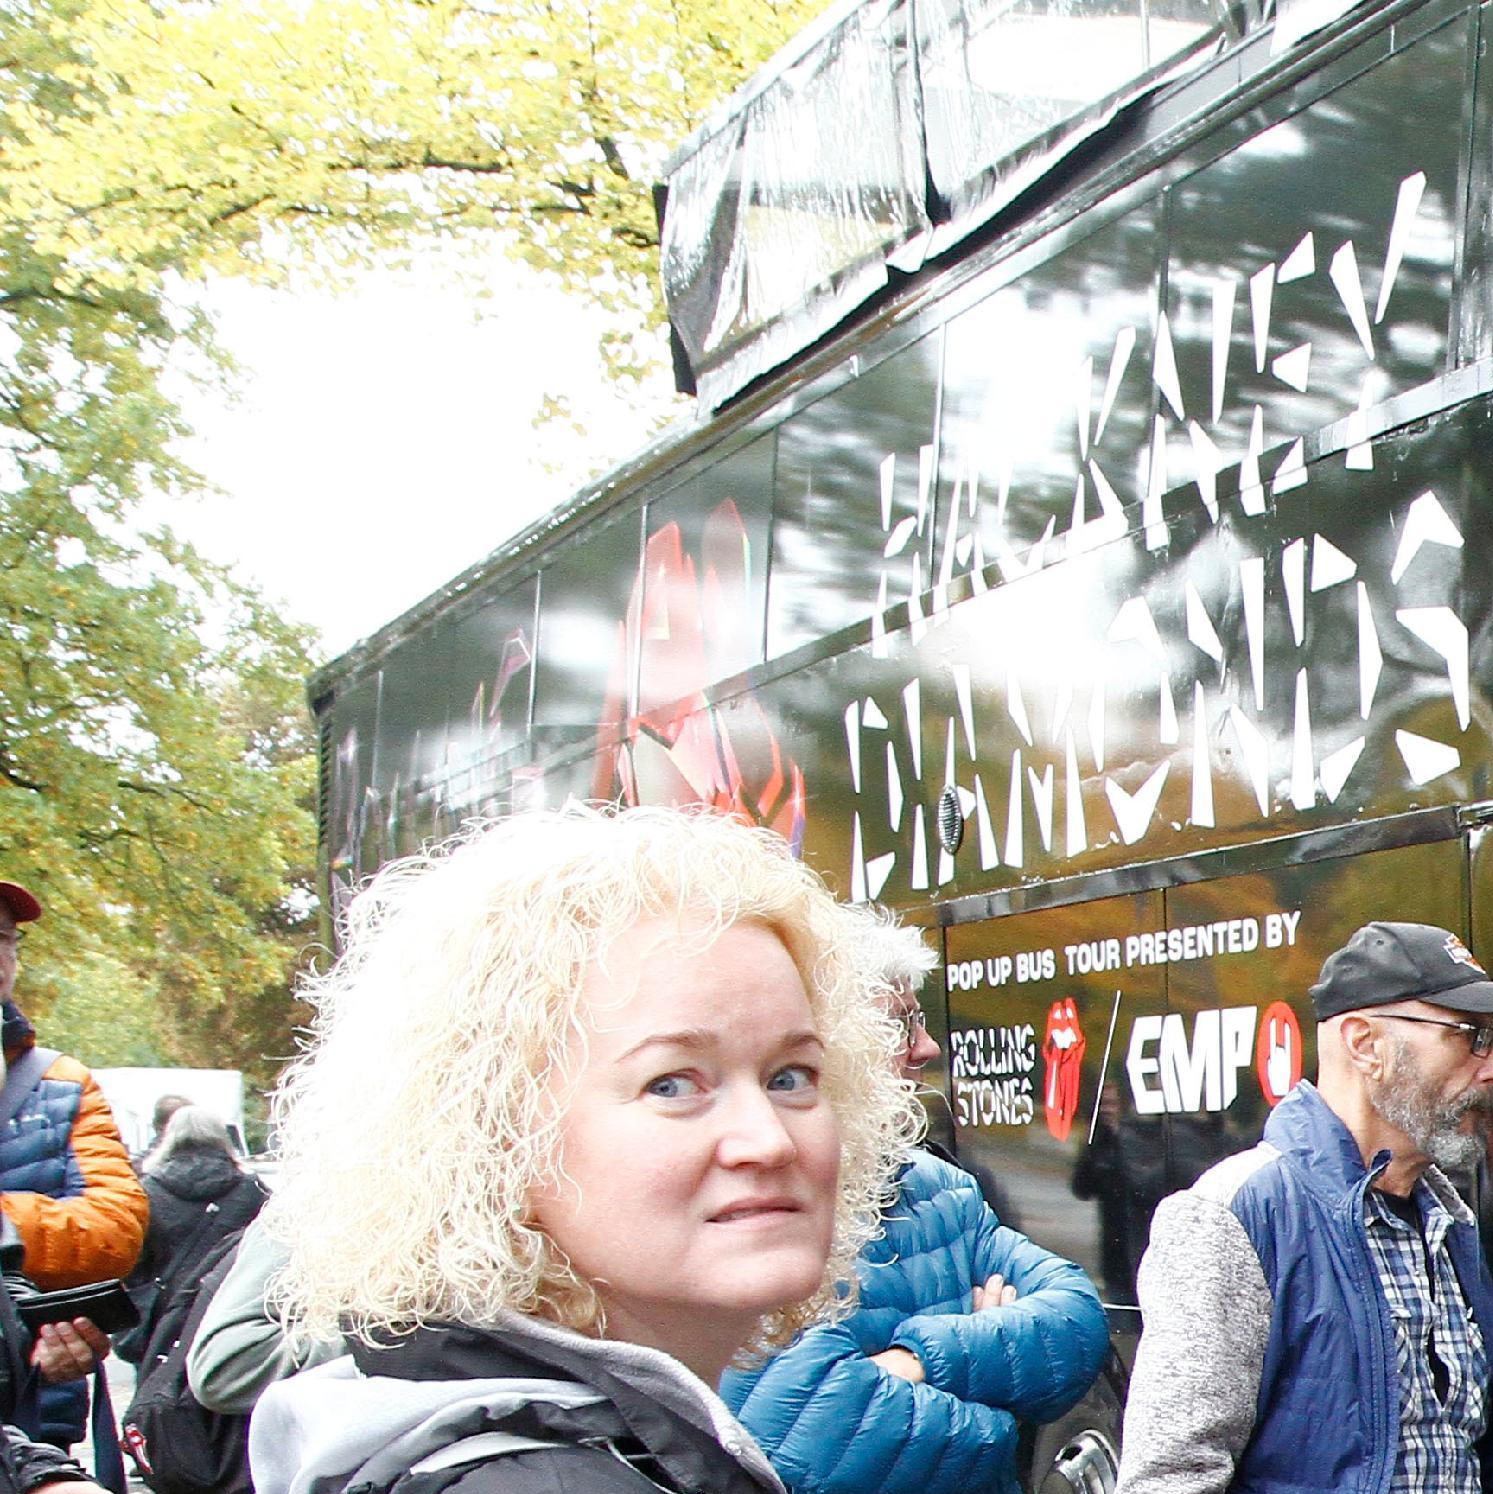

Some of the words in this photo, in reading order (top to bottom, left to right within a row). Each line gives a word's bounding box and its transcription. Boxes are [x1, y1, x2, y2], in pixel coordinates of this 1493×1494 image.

[947, 961, 985, 992] POP
[986, 957, 1012, 984] UP
[1017, 947, 1056, 982] BUS
[1065, 939, 1121, 975] TOUR
[1126, 919, 1259, 968] PRESENTED
[1266, 911, 1302, 946] BY
[951, 1023, 1036, 1076] ROLLING
[1126, 1005, 1258, 1115] EMP
[957, 1076, 1034, 1128] STONES
